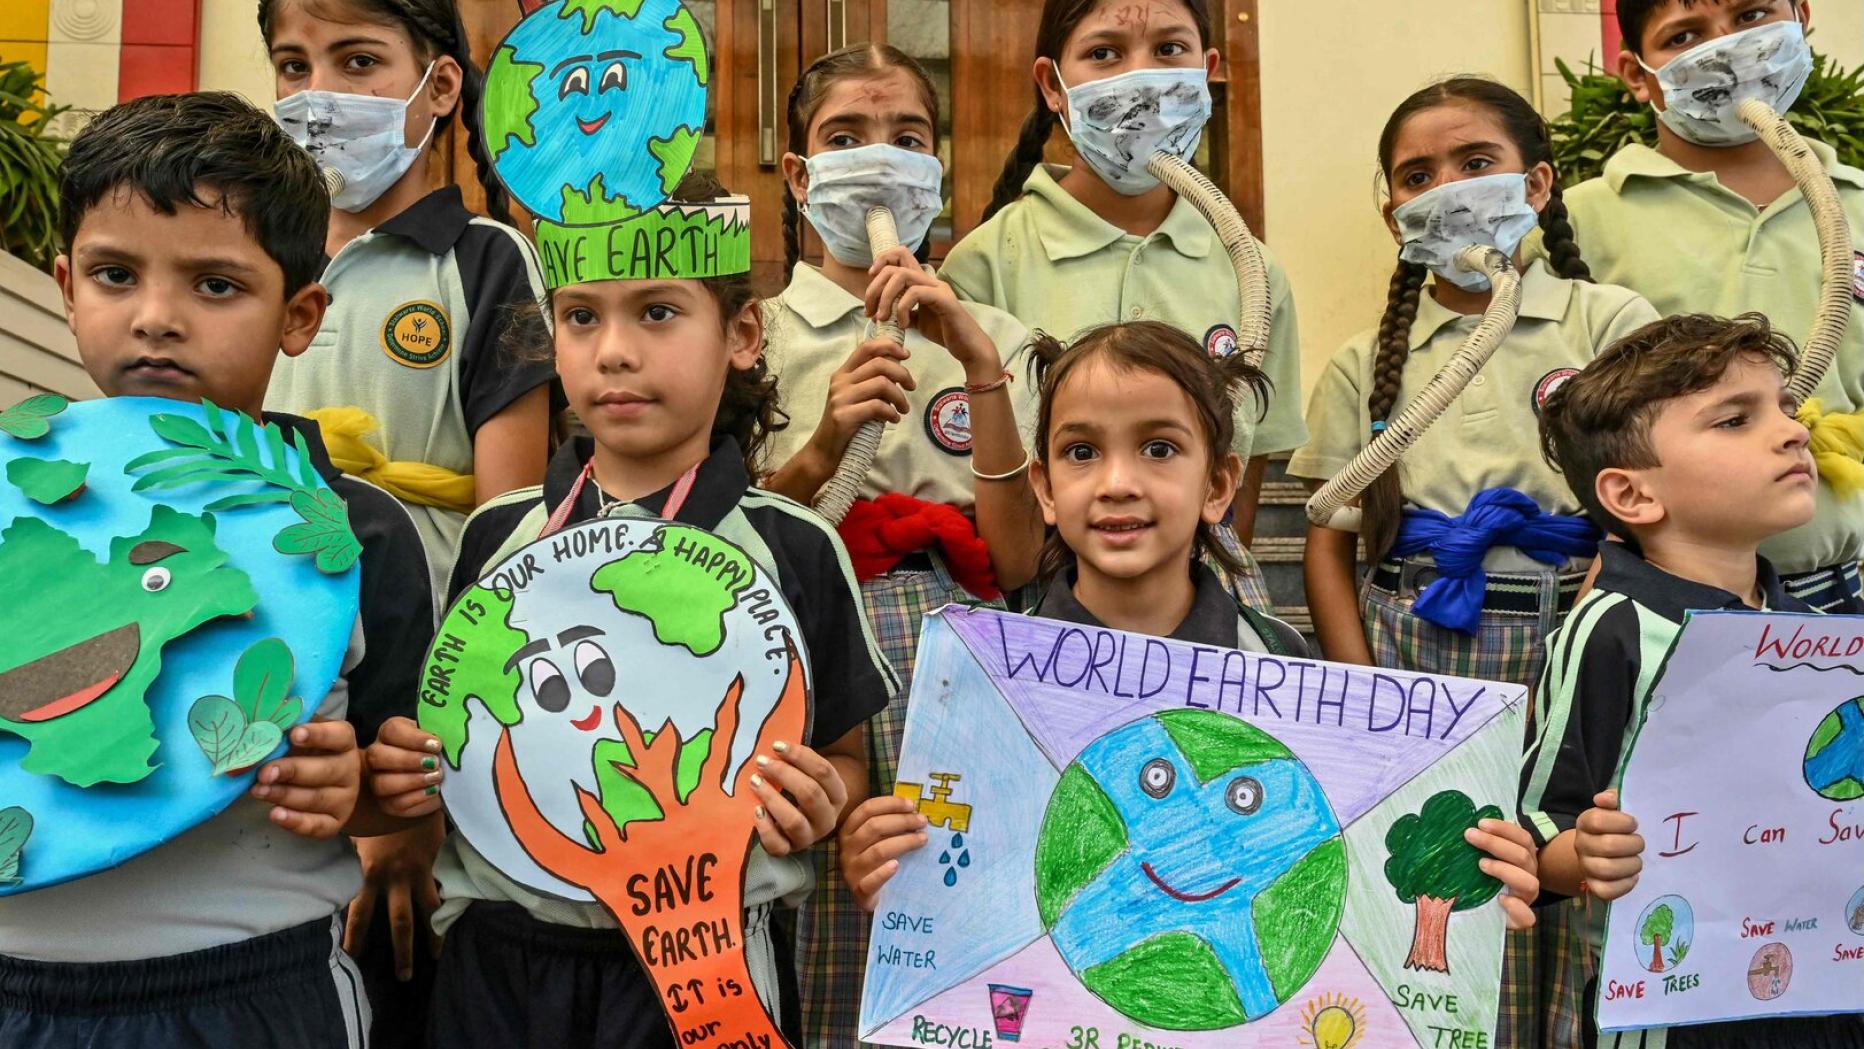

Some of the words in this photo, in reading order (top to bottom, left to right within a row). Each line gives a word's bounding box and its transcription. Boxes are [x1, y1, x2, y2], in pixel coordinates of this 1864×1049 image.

[543, 236, 587, 288] AVE
[607, 225, 719, 278] EARTH
[401, 332, 433, 347] HOPE
[421, 633, 467, 708] EARTH
[459, 599, 487, 626] IS
[491, 553, 545, 602] OUR
[553, 523, 634, 563] HOME.
[639, 525, 667, 552] A
[673, 536, 748, 591] HAPPY
[1754, 622, 1864, 660] WORLD
[998, 616, 1171, 700] WORLD
[1185, 647, 1350, 728] EARTH
[1368, 672, 1486, 740] DAY
[1659, 811, 1700, 858] I
[1743, 824, 1785, 845] can
[626, 853, 718, 916] SAVE
[881, 912, 934, 935] SAVE
[1740, 916, 1776, 938] SAVE
[1783, 917, 1818, 933] WATER
[642, 918, 736, 967] EARTH.
[1833, 943, 1864, 962] SAVE
[877, 946, 936, 970] WATER
[667, 979, 704, 1013] IT
[717, 978, 743, 997] is
[1394, 984, 1458, 1014] SAVE
[1605, 979, 1646, 1001] SAVE
[1662, 973, 1700, 996] TREES
[681, 1021, 721, 1045] our
[911, 1014, 993, 1049] RECYCLE
[1066, 1025, 1100, 1049] 3R
[1427, 1025, 1488, 1049] TREE
